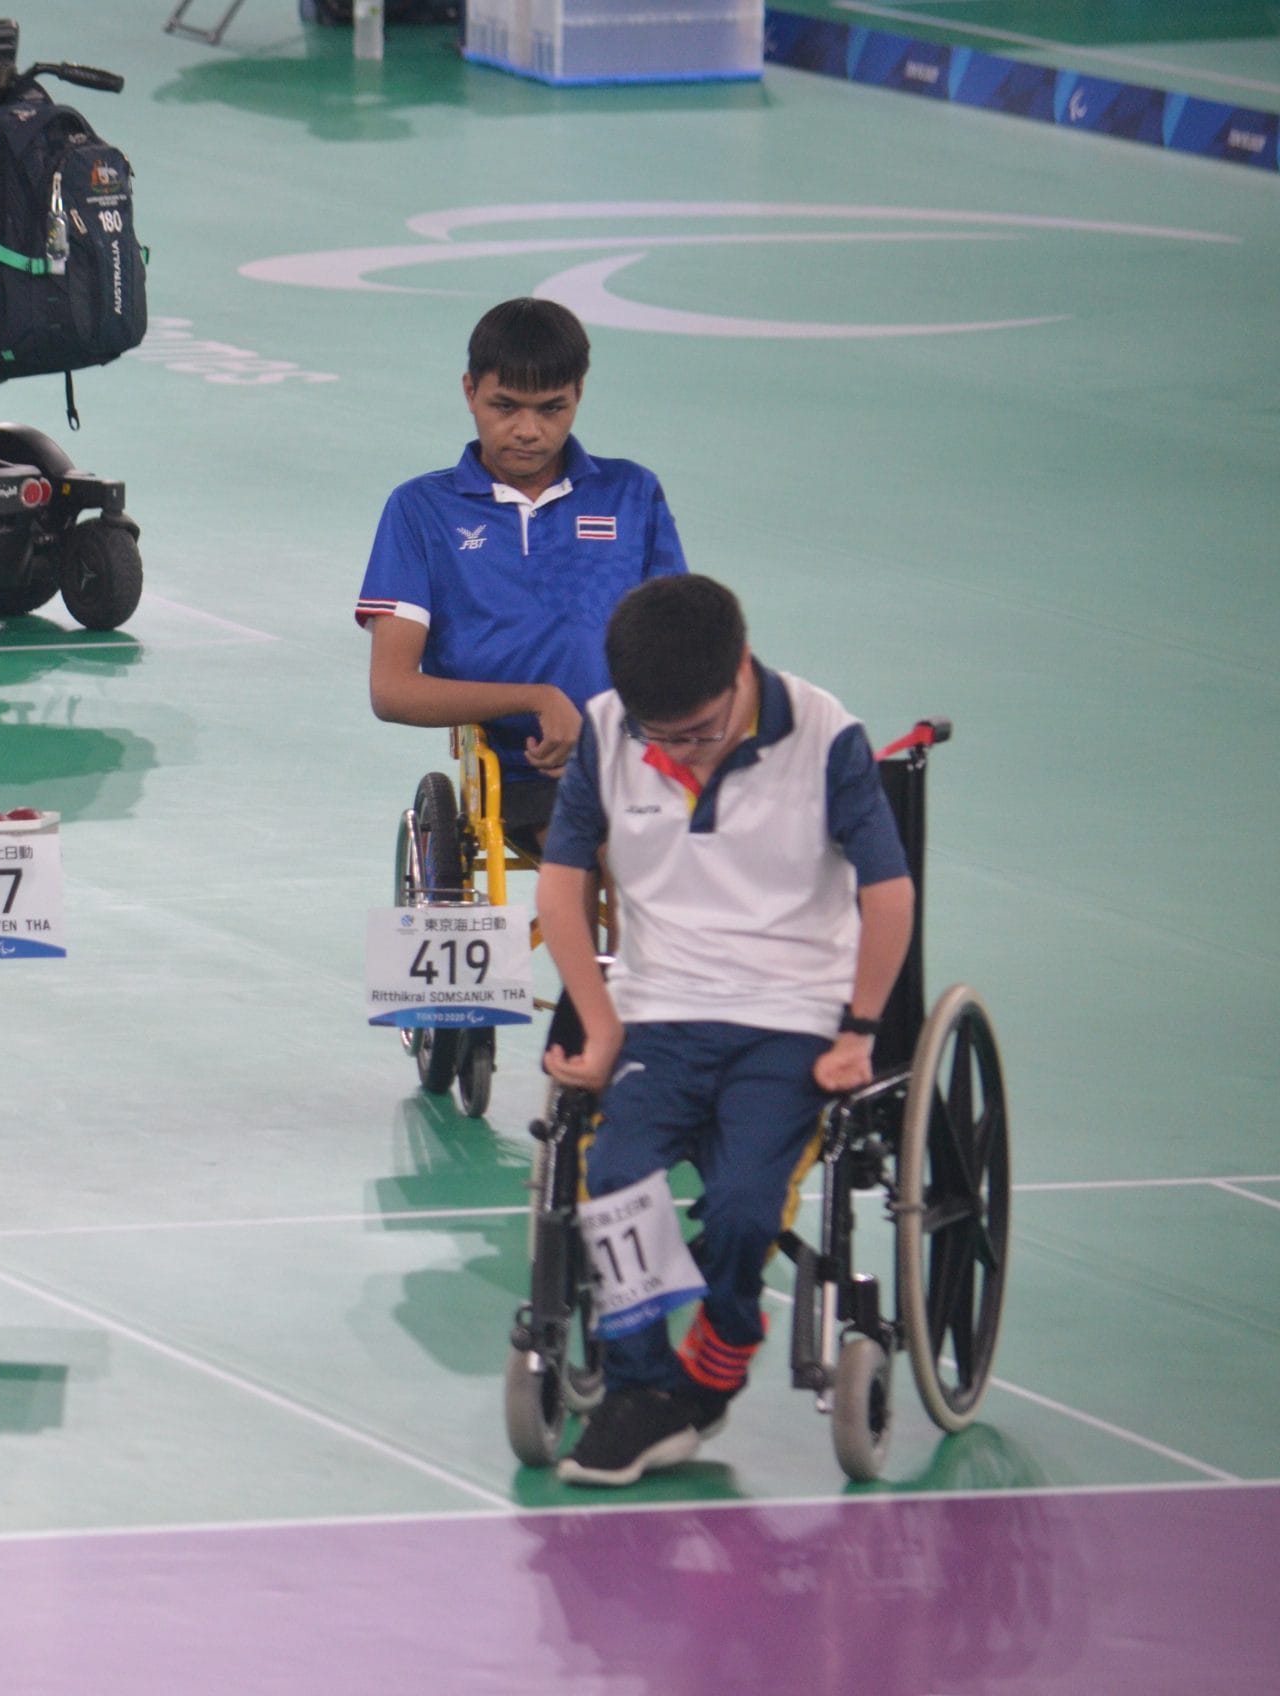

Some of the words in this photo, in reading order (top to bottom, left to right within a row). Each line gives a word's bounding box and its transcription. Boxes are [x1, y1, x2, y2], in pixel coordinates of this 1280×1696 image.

[98, 209, 123, 233] 180
[111, 239, 123, 315] AUSTRALIA
[458, 538, 488, 550] FBT
[25, 918, 51, 932] THA
[424, 916, 507, 932] 東京海上日動
[409, 938, 491, 986] 419
[371, 989, 426, 1003] Ritthikrai
[429, 990, 495, 1003] SOMSANUK
[502, 988, 527, 1000] THA
[415, 1012, 444, 1022] TOKYO
[444, 1012, 466, 1022] 2020
[589, 1225, 648, 1285] 11
